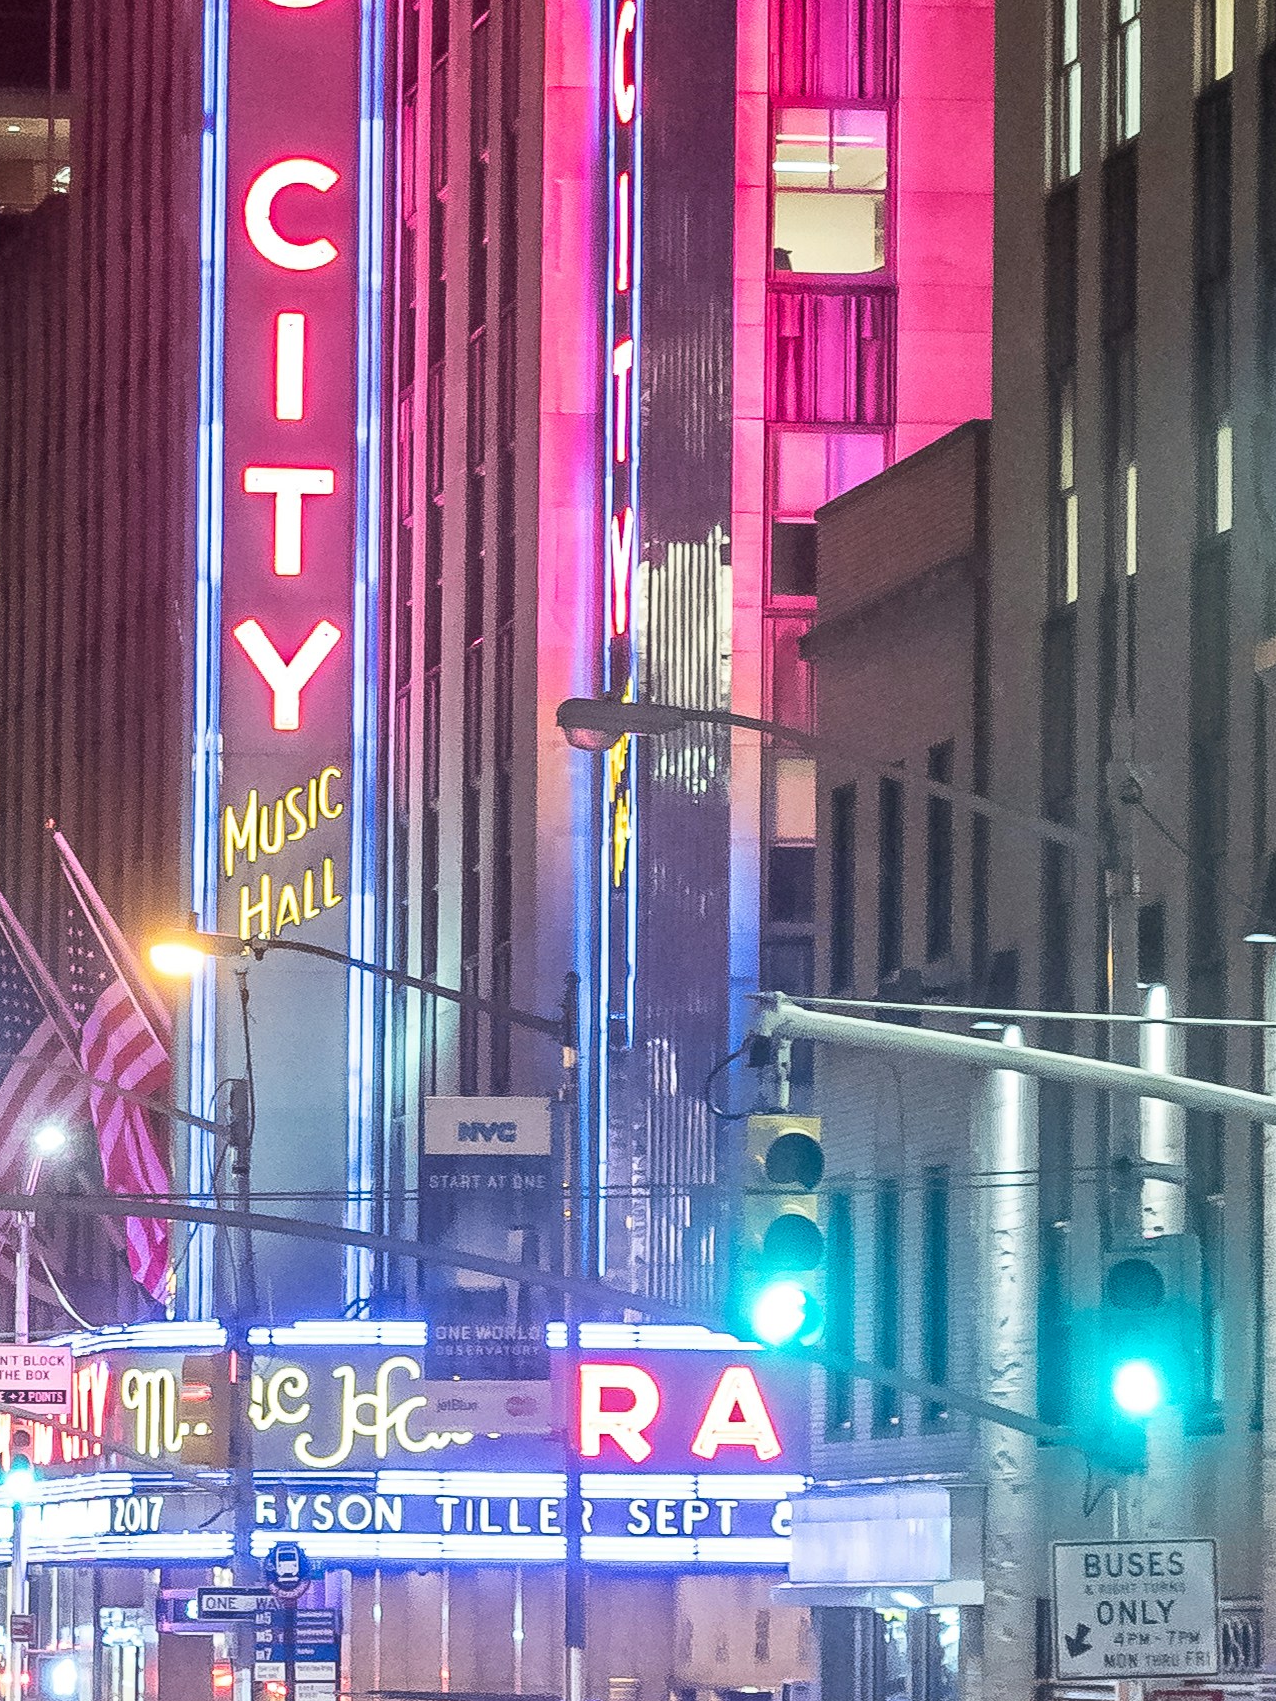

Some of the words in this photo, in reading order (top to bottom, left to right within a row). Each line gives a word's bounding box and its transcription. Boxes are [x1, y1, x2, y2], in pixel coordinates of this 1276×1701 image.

[233, 158, 342, 731] CITY
[239, 857, 343, 940] HALL
[457, 1120, 518, 1142] NYC
[428, 1174, 481, 1189] START
[487, 1174, 507, 1189] AT
[512, 1173, 546, 1189] ONE
[435, 1325, 471, 1341] ONE
[475, 1325, 541, 1341] WORLD
[23, 1355, 65, 1366] BLOCK
[25, 1370, 51, 1381] BOX
[27, 1391, 64, 1403] POINTS
[113, 1496, 164, 1532] 2017
[625, 1499, 738, 1535] SEPT
[1083, 1551, 1186, 1578] BUSES
[205, 1596, 237, 1610] ONE
[1096, 1599, 1175, 1626] ONLY
[1103, 1653, 1139, 1669] MON
[1184, 1650, 1211, 1667] FRI
